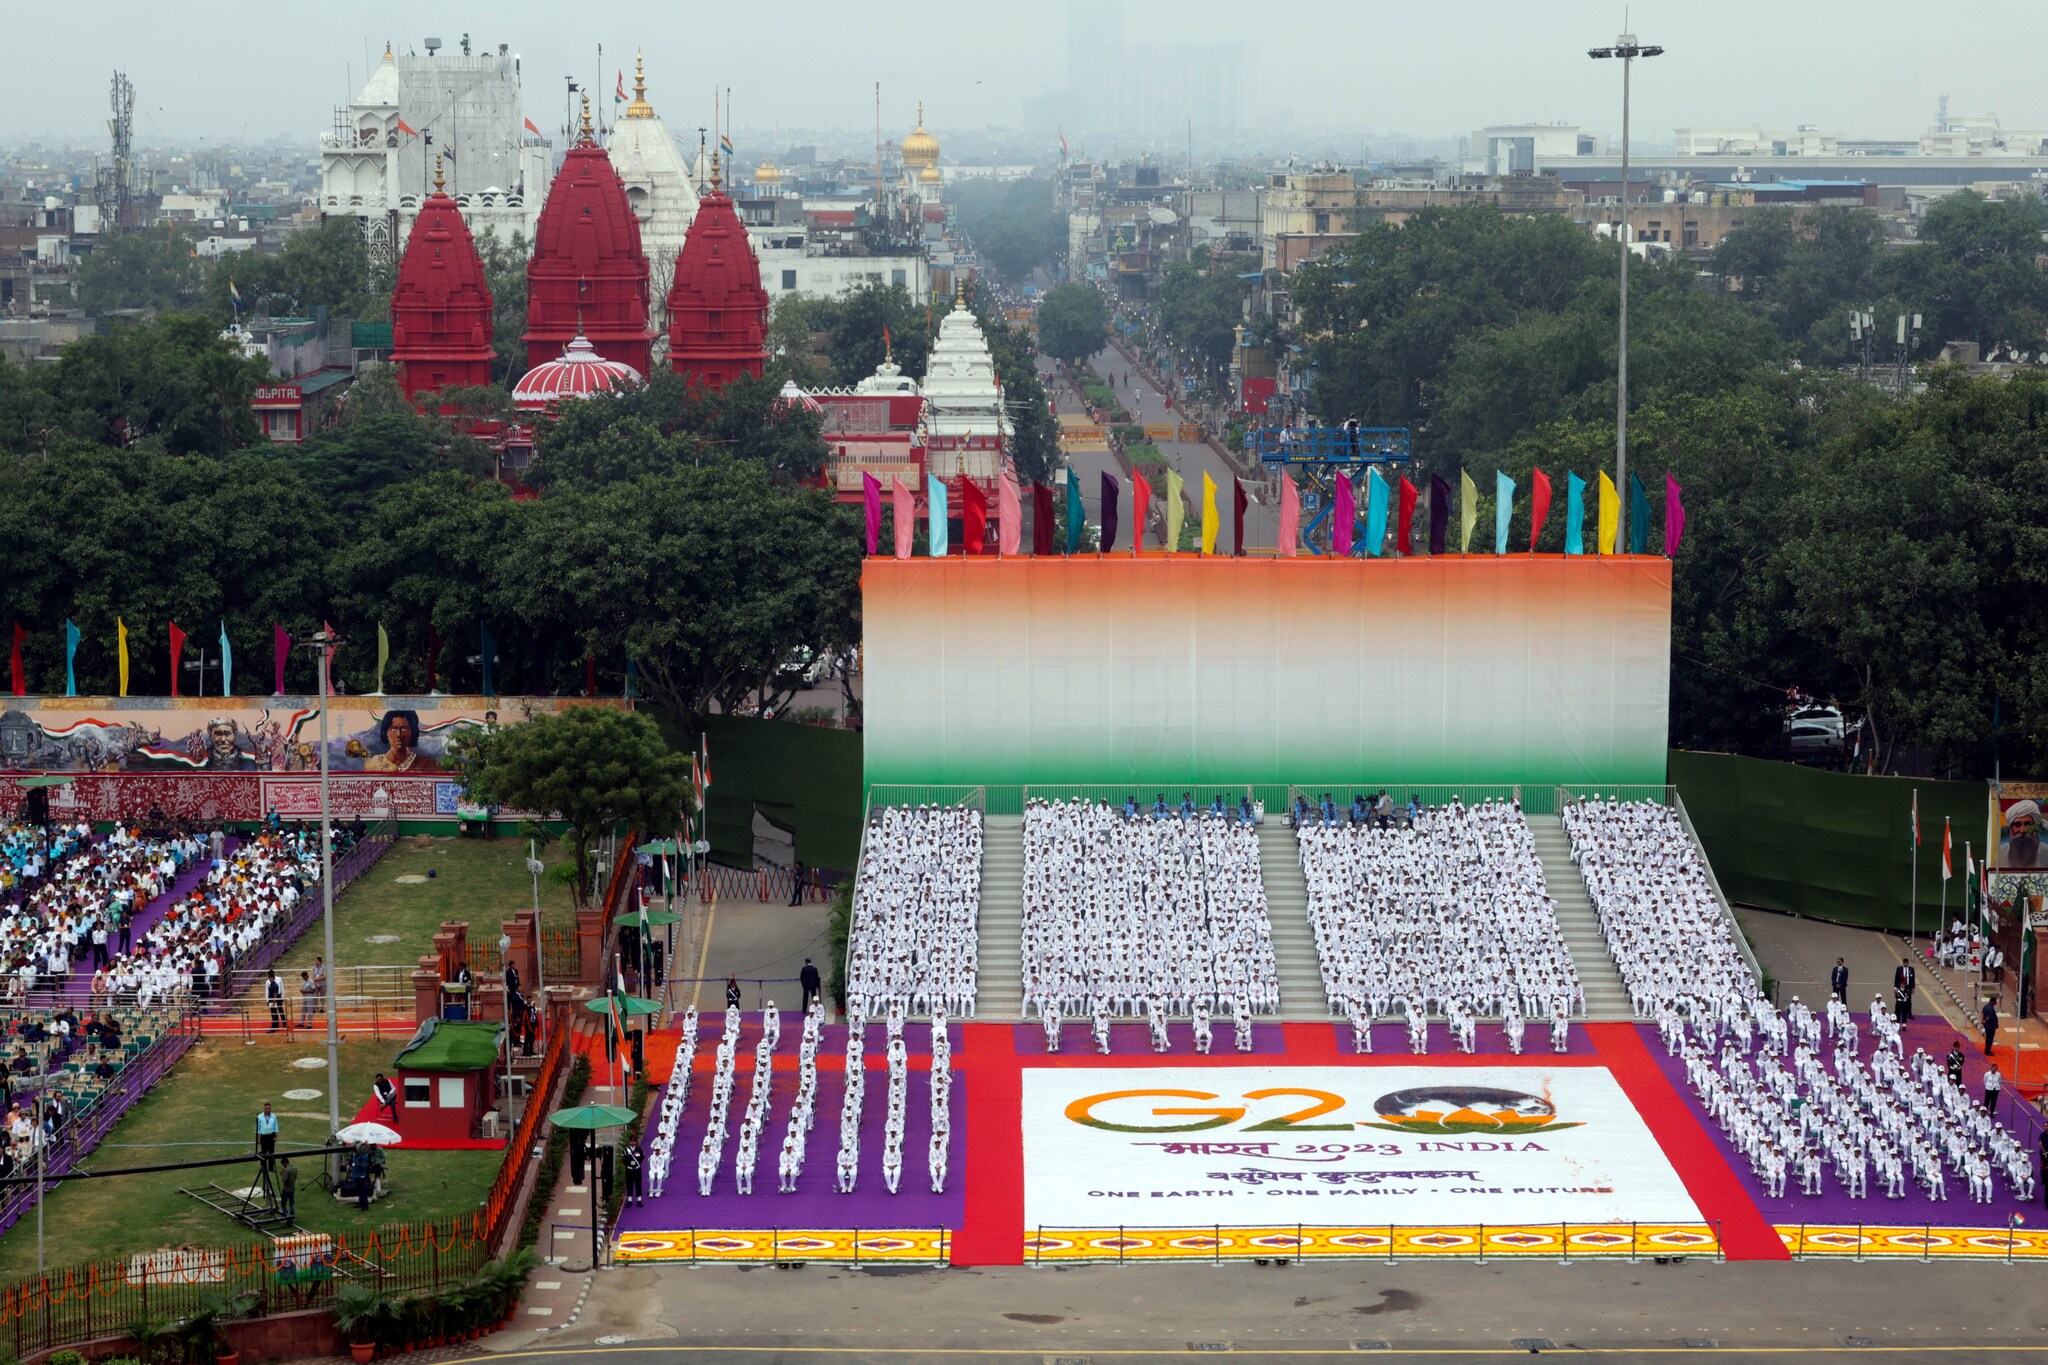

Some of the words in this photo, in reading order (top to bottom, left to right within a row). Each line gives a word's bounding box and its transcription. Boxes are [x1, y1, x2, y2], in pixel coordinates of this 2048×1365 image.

[1130, 1142, 1283, 1160] भारत
[1296, 1143, 1402, 1156] 2023
[1416, 1141, 1550, 1152] INDIA
[1087, 1190, 1141, 1198] ONE
[1150, 1190, 1234, 1198] EARTH
[1329, 1188, 1418, 1196] FAMILY
[1512, 1186, 1615, 1194] FUTURE
